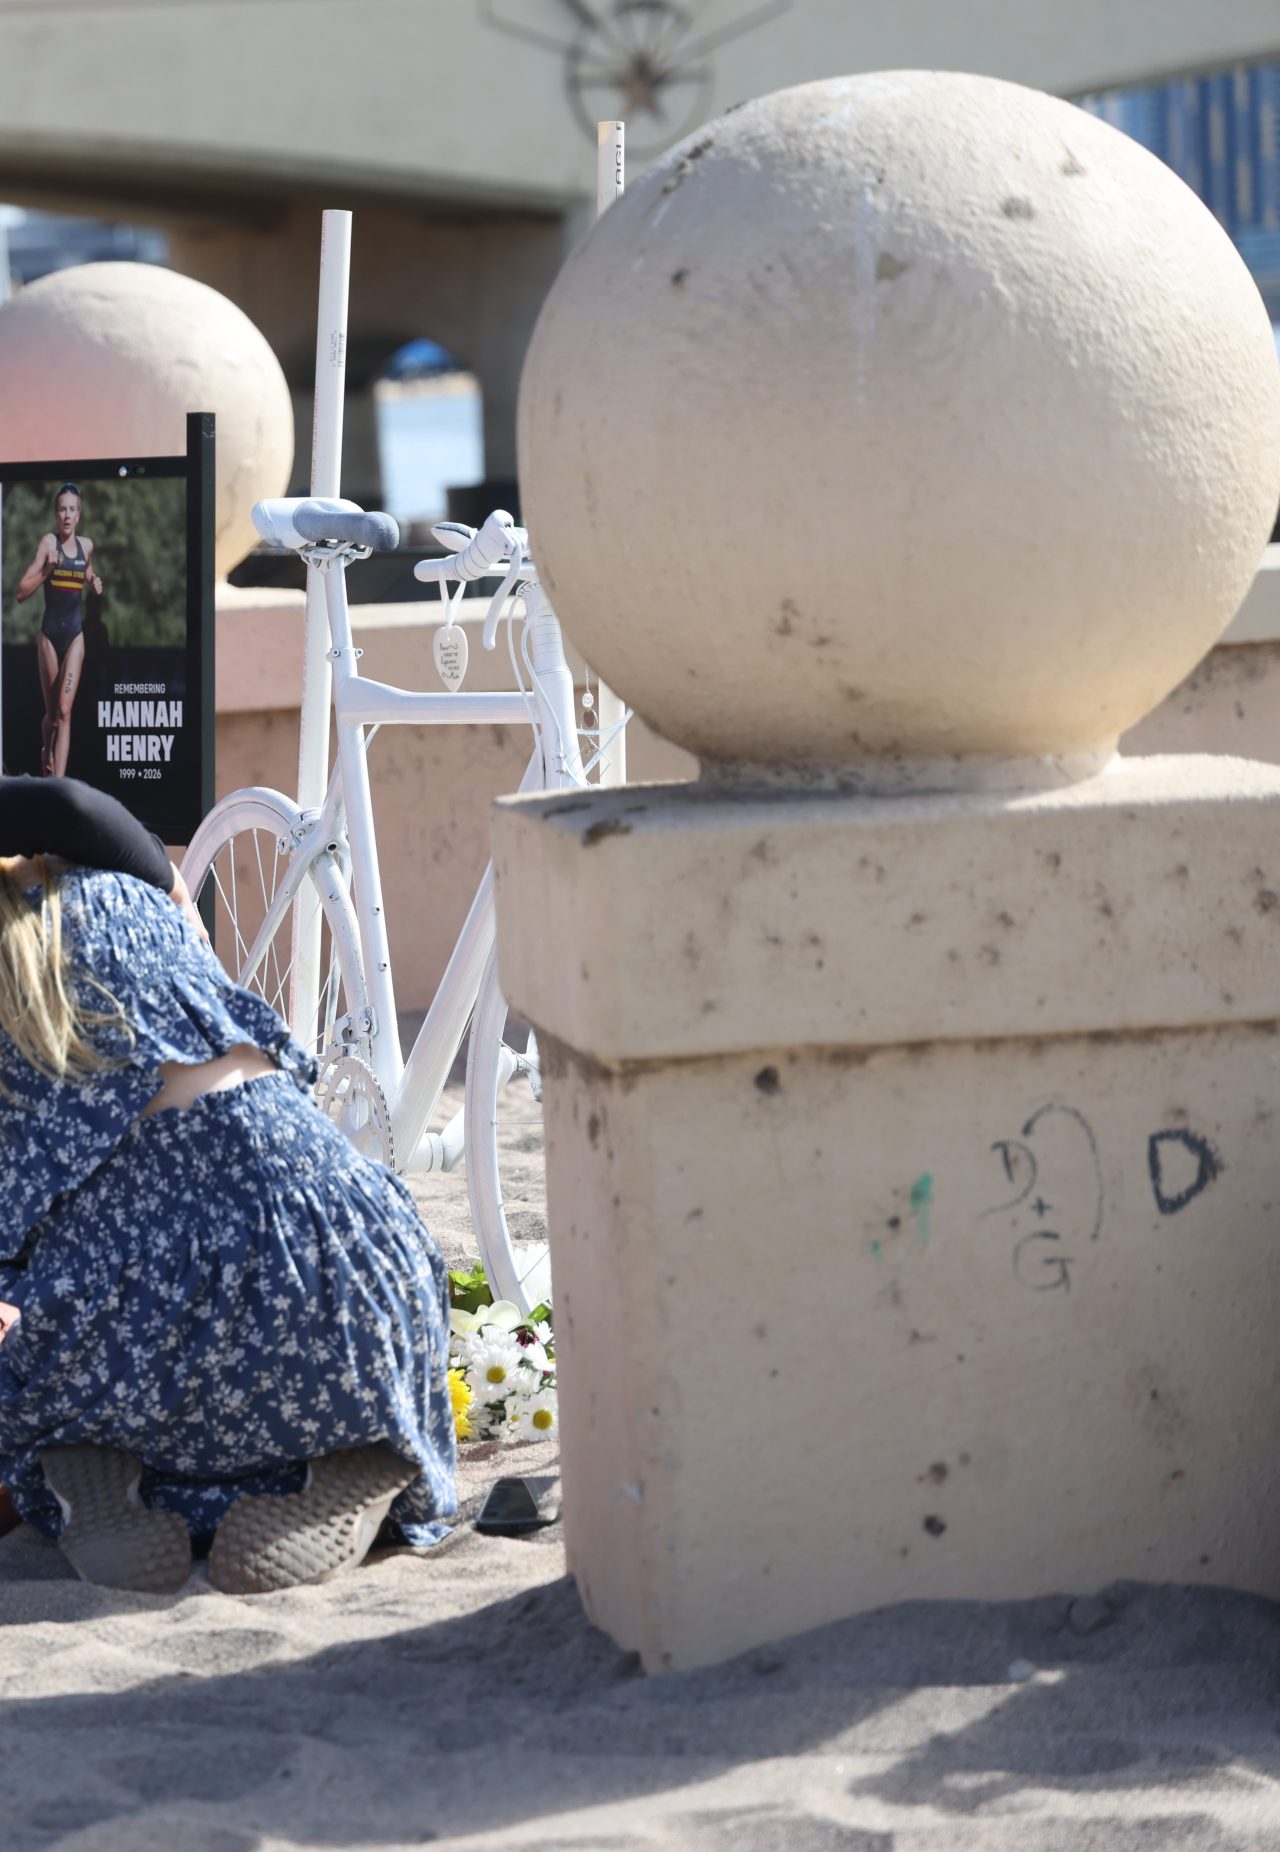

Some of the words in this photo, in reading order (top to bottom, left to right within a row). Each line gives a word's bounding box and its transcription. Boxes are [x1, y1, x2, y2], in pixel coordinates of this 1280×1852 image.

[114, 683, 166, 694] REMEMBERING
[97, 700, 183, 728] HANNAH
[106, 734, 175, 762] HENRY
[119, 768, 136, 779] 1999
[143, 768, 162, 779] 2026
